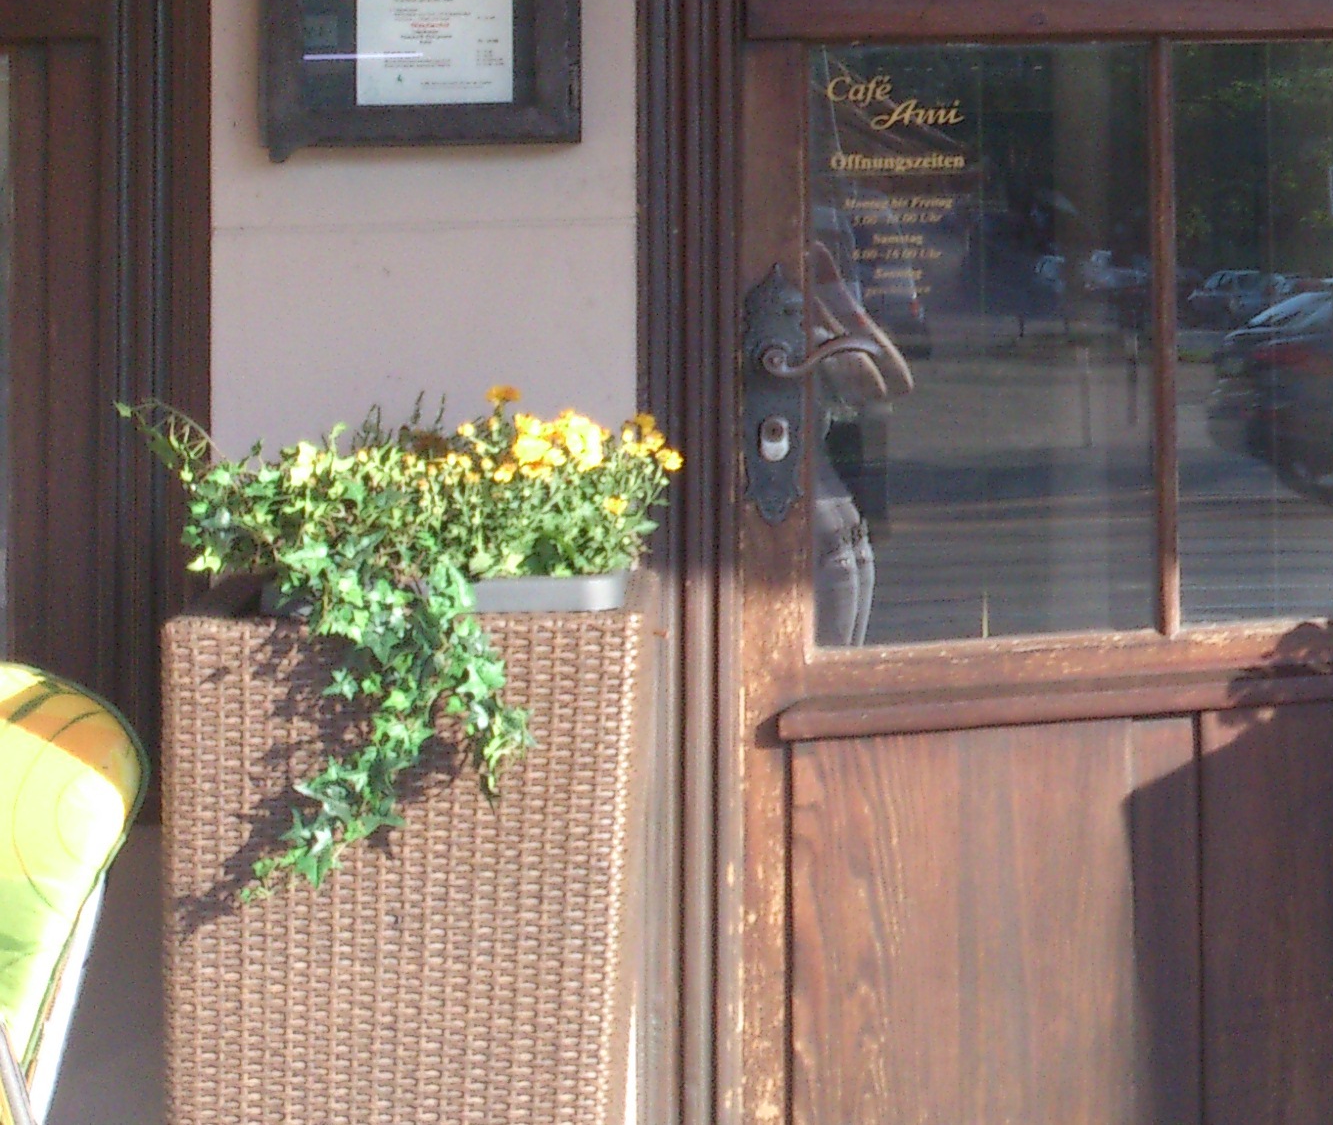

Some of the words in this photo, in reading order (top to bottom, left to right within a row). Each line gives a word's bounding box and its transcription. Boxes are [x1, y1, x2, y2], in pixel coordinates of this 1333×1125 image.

[827, 74, 893, 108] Café
[870, 98, 965, 130] Ami
[830, 151, 966, 172] Öffnungszeiten
